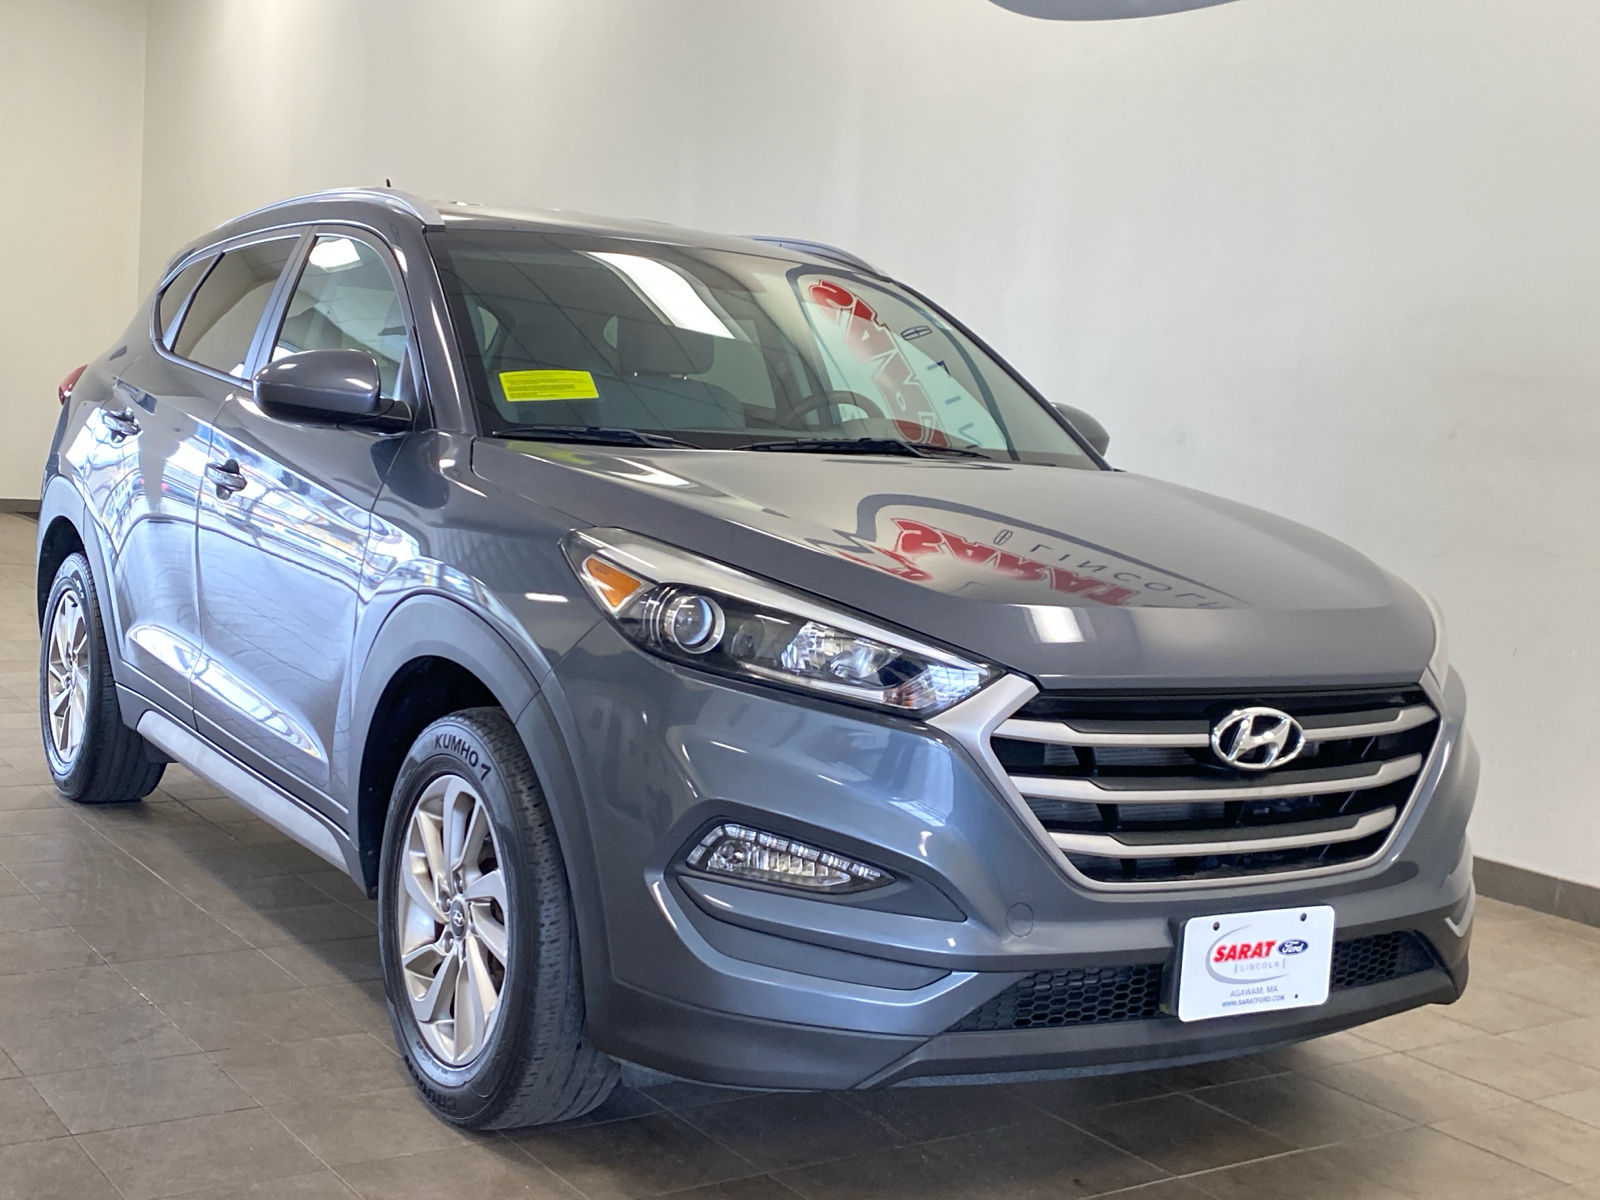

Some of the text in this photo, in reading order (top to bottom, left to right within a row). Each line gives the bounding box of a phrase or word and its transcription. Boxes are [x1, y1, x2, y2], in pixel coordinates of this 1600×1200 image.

[434, 733, 479, 768] KUMHO
[1213, 940, 1306, 963] SARAT Ford
[1240, 960, 1280, 972] LINCOLN
[1266, 985, 1278, 994] MA
